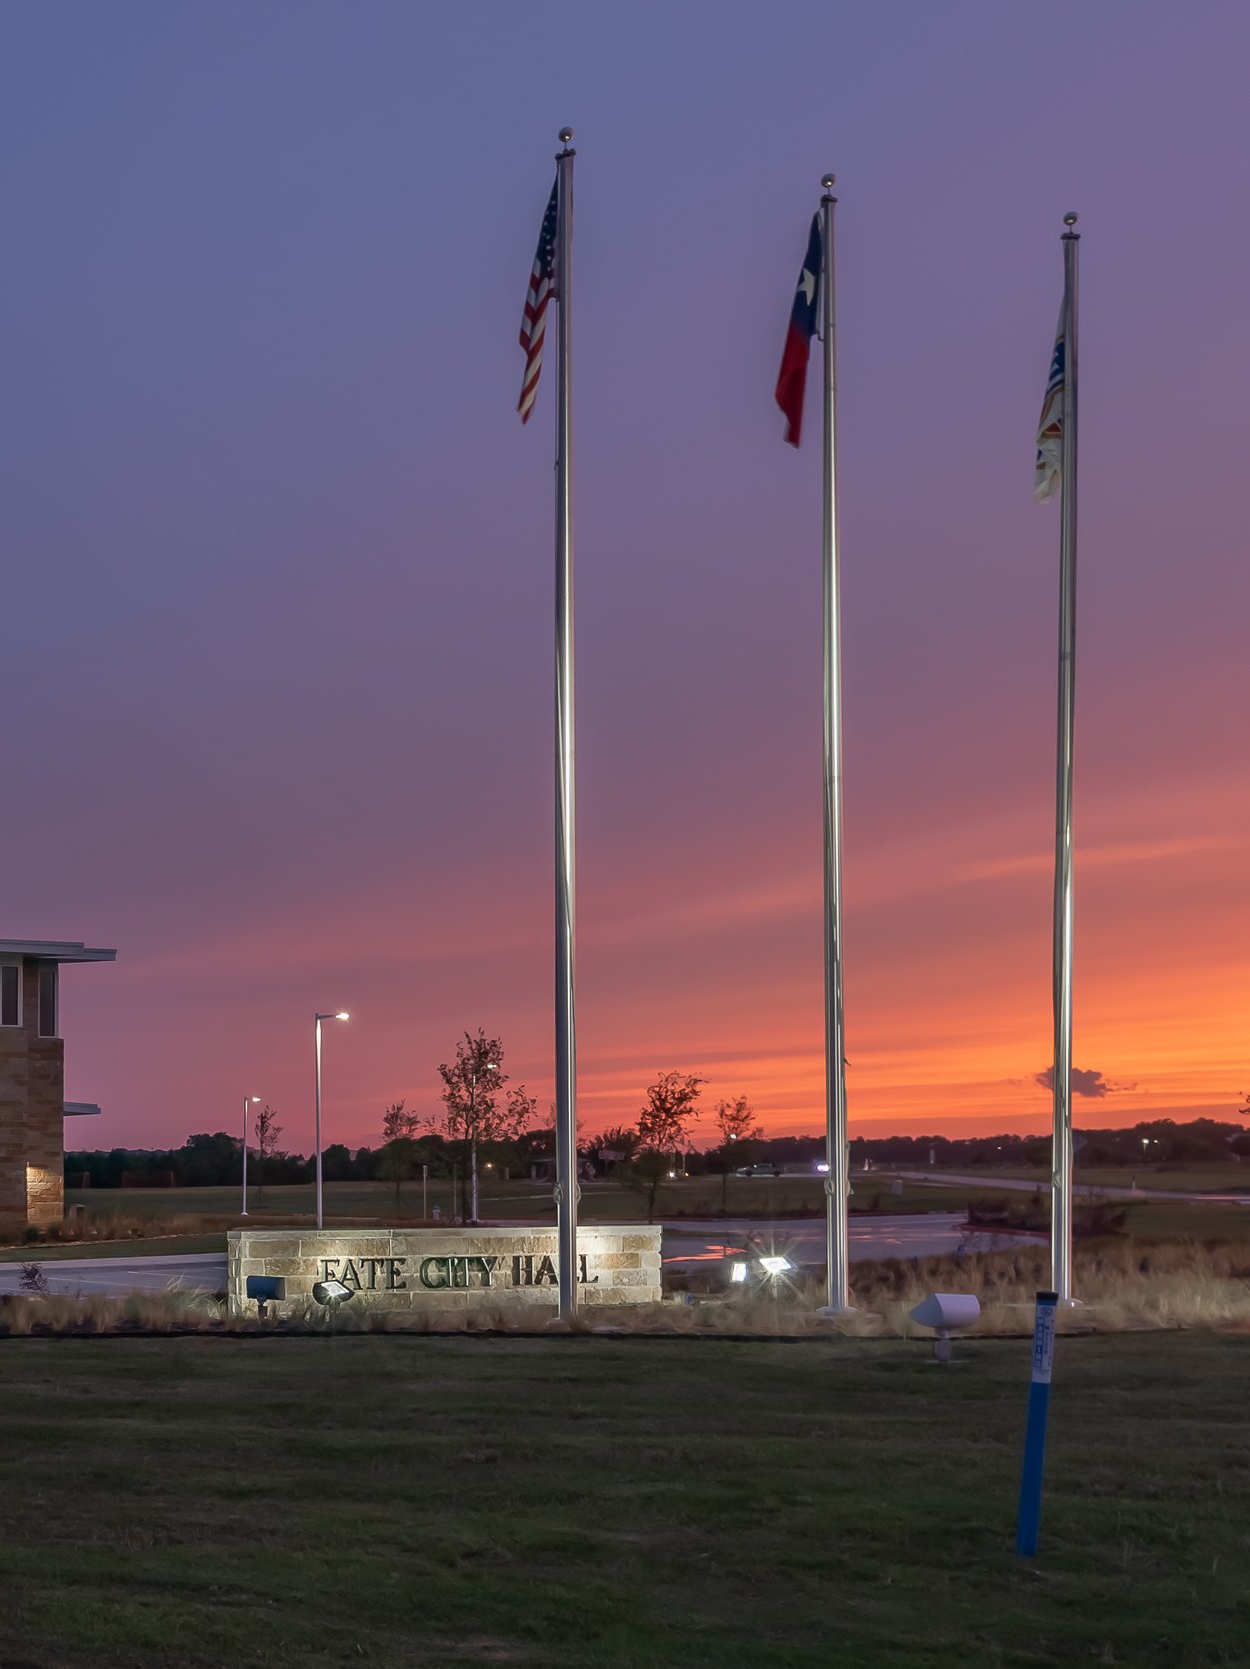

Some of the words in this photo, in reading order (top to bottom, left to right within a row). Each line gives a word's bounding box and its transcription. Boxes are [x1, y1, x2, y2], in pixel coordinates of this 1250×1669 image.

[320, 1258, 406, 1289] FATE
[419, 1256, 499, 1288] CITY
[513, 1255, 598, 1285] HAL
